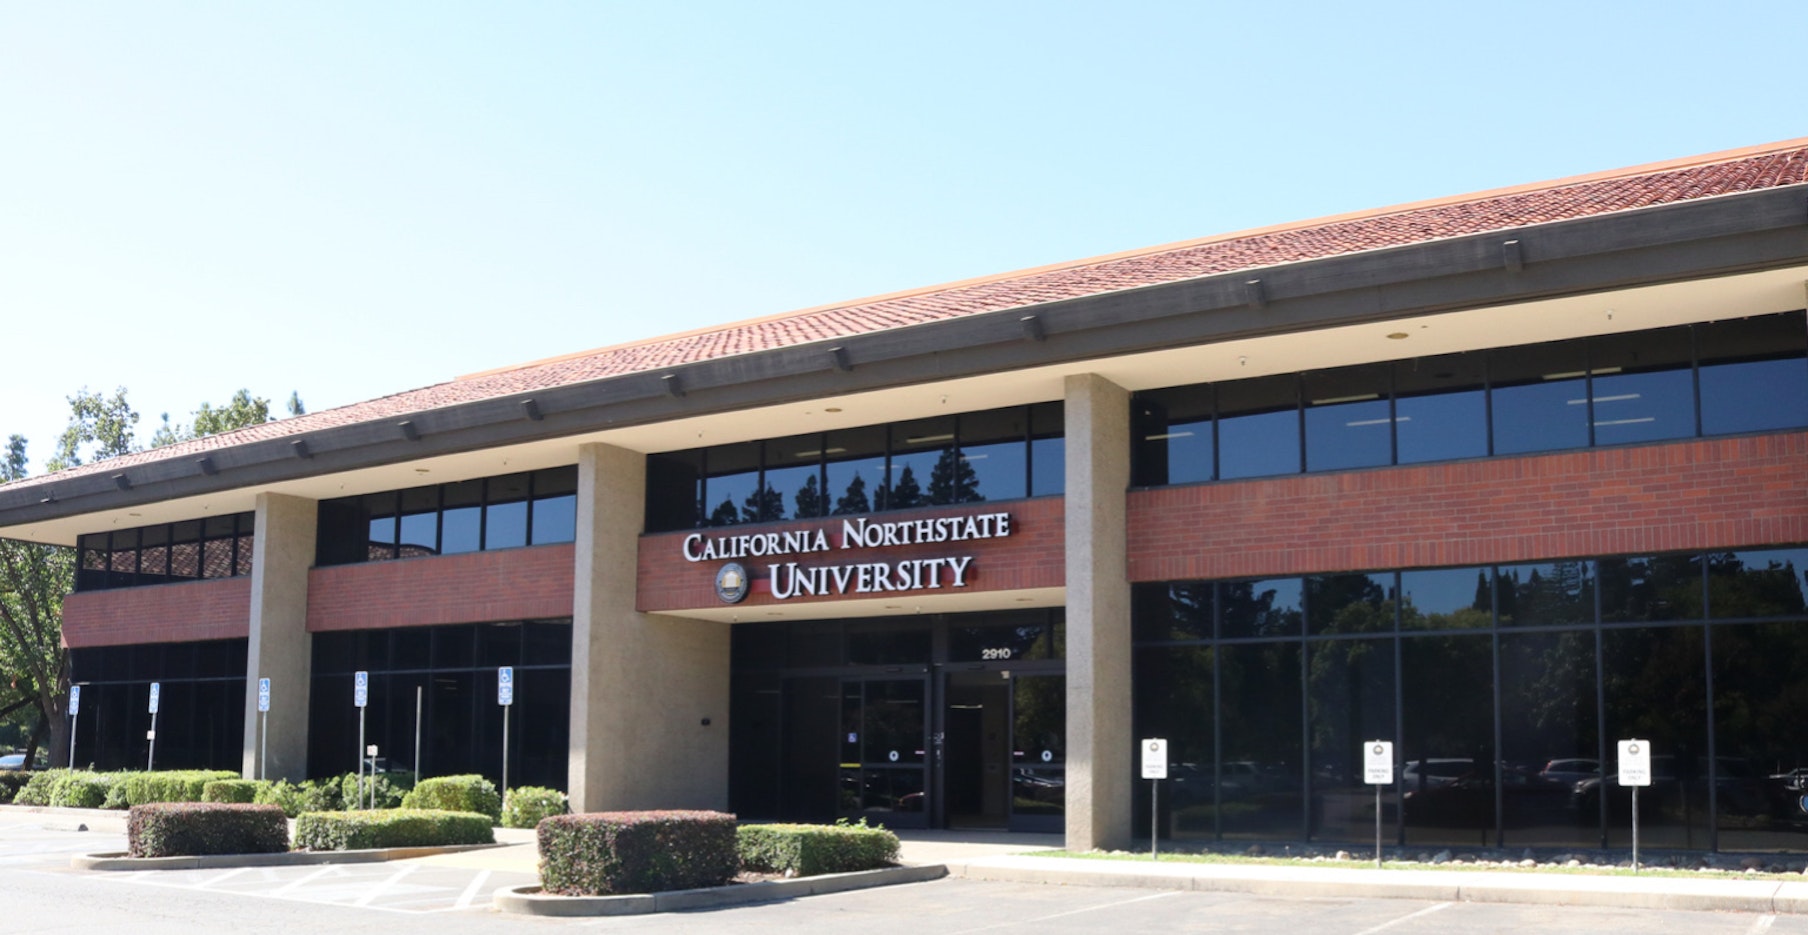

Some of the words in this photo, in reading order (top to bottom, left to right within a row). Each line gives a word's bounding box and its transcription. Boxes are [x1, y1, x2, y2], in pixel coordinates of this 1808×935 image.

[682, 528, 830, 563] CALIFORNIA
[840, 512, 1010, 550] NORTHSTATE
[768, 556, 974, 600] UNIVERSITY
[982, 648, 1011, 659] 2910
